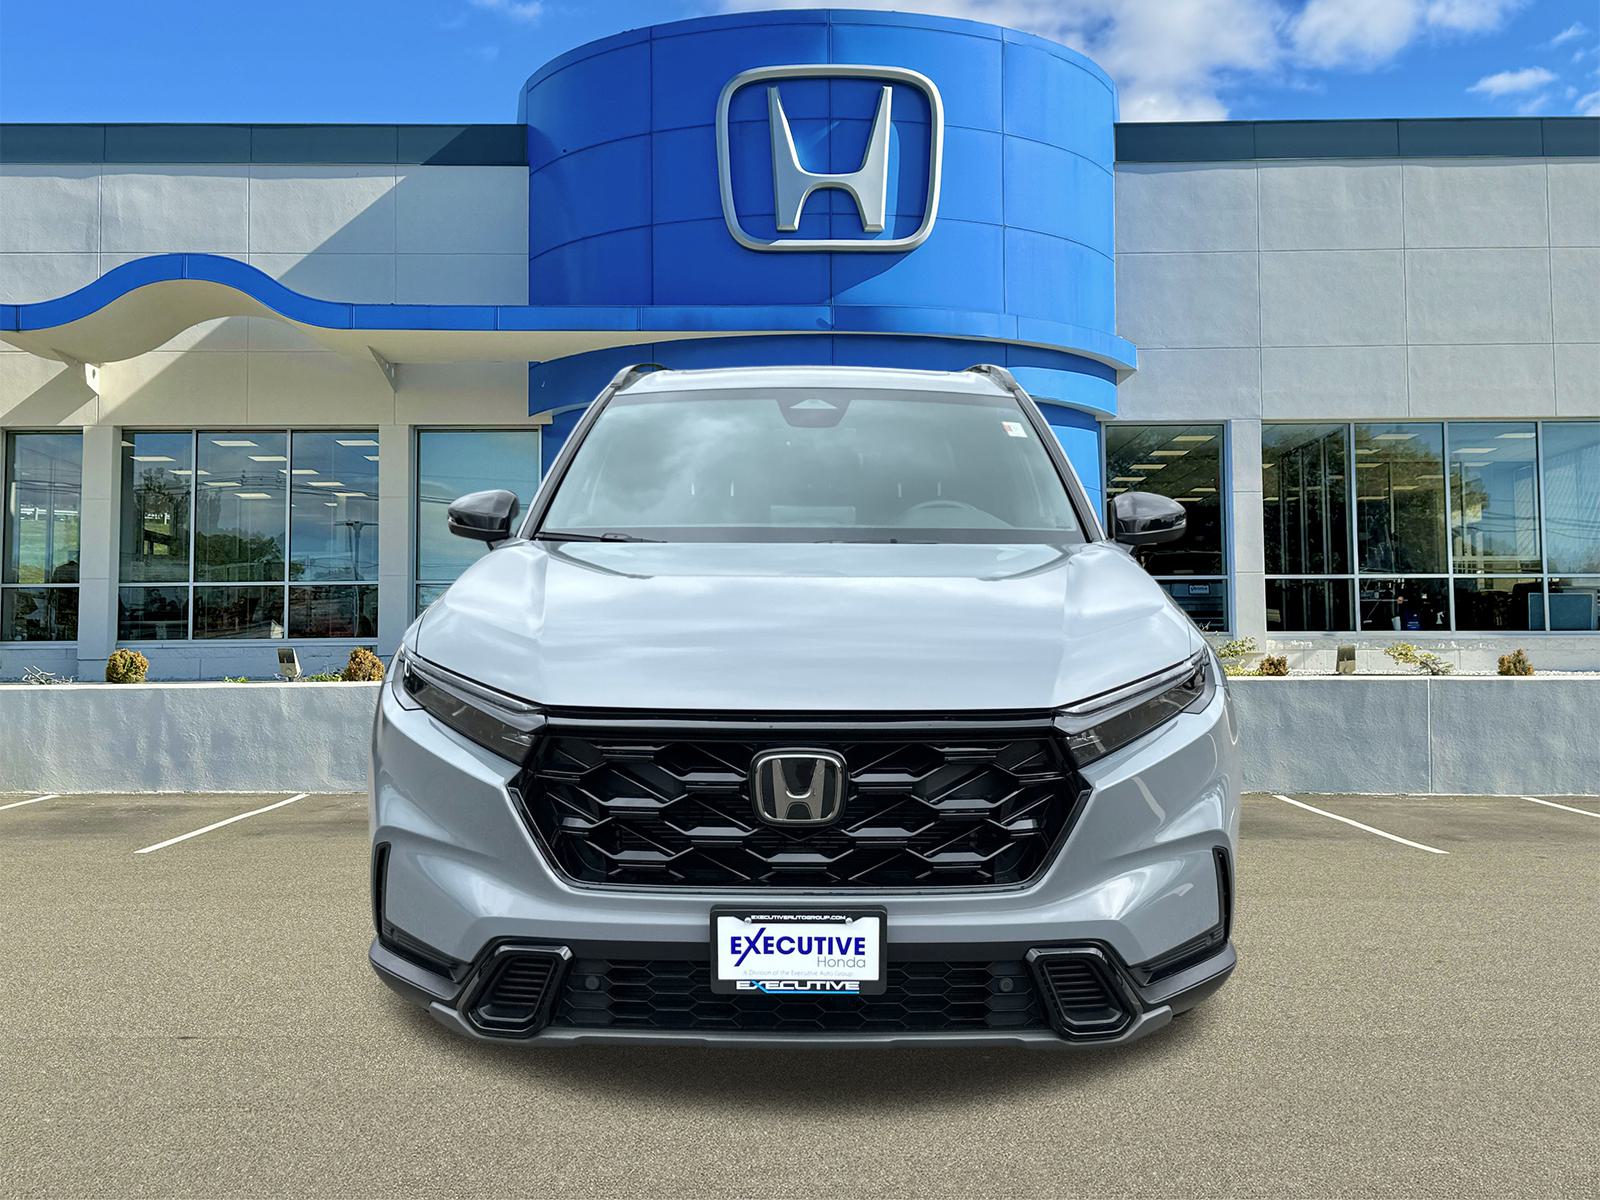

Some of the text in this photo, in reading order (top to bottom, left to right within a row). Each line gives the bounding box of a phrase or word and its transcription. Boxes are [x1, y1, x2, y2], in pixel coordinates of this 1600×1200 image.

[730, 927, 866, 967] EXECUTIVE
[816, 956, 866, 968] Honda
[735, 980, 860, 993] EXECUTIVE
